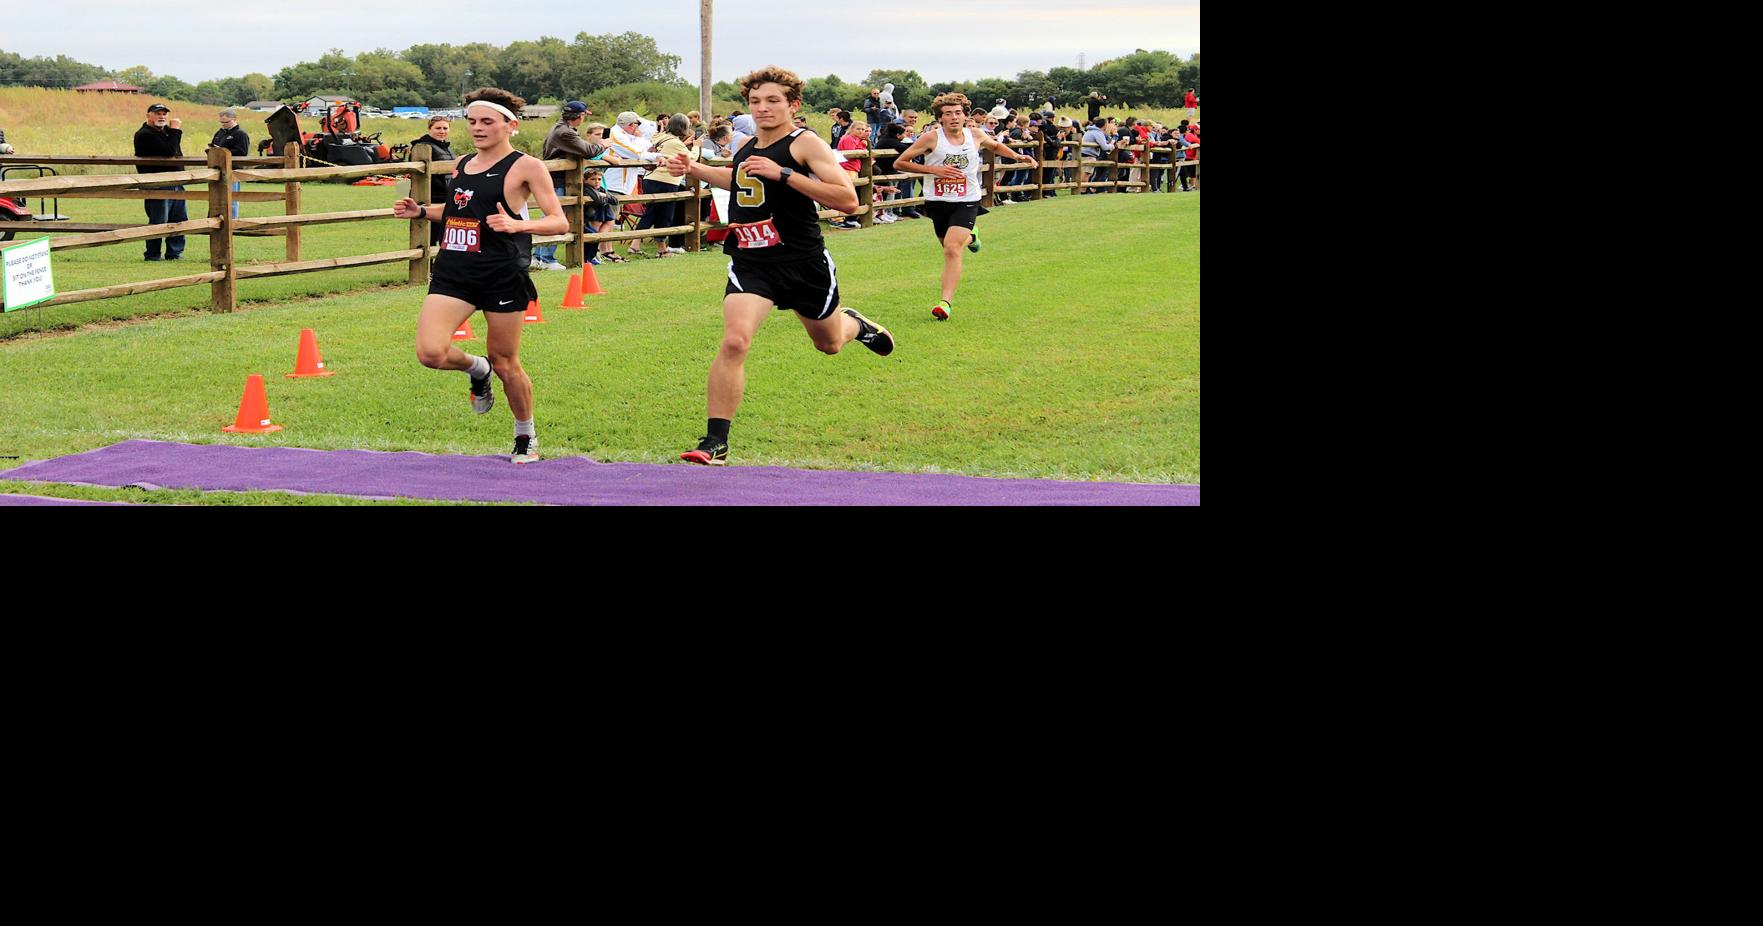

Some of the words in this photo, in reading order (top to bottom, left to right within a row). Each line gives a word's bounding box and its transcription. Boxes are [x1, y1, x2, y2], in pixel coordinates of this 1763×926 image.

[736, 161, 765, 207] S
[937, 183, 964, 193] 1625
[444, 227, 477, 246] 1006
[735, 224, 775, 242] 1914
